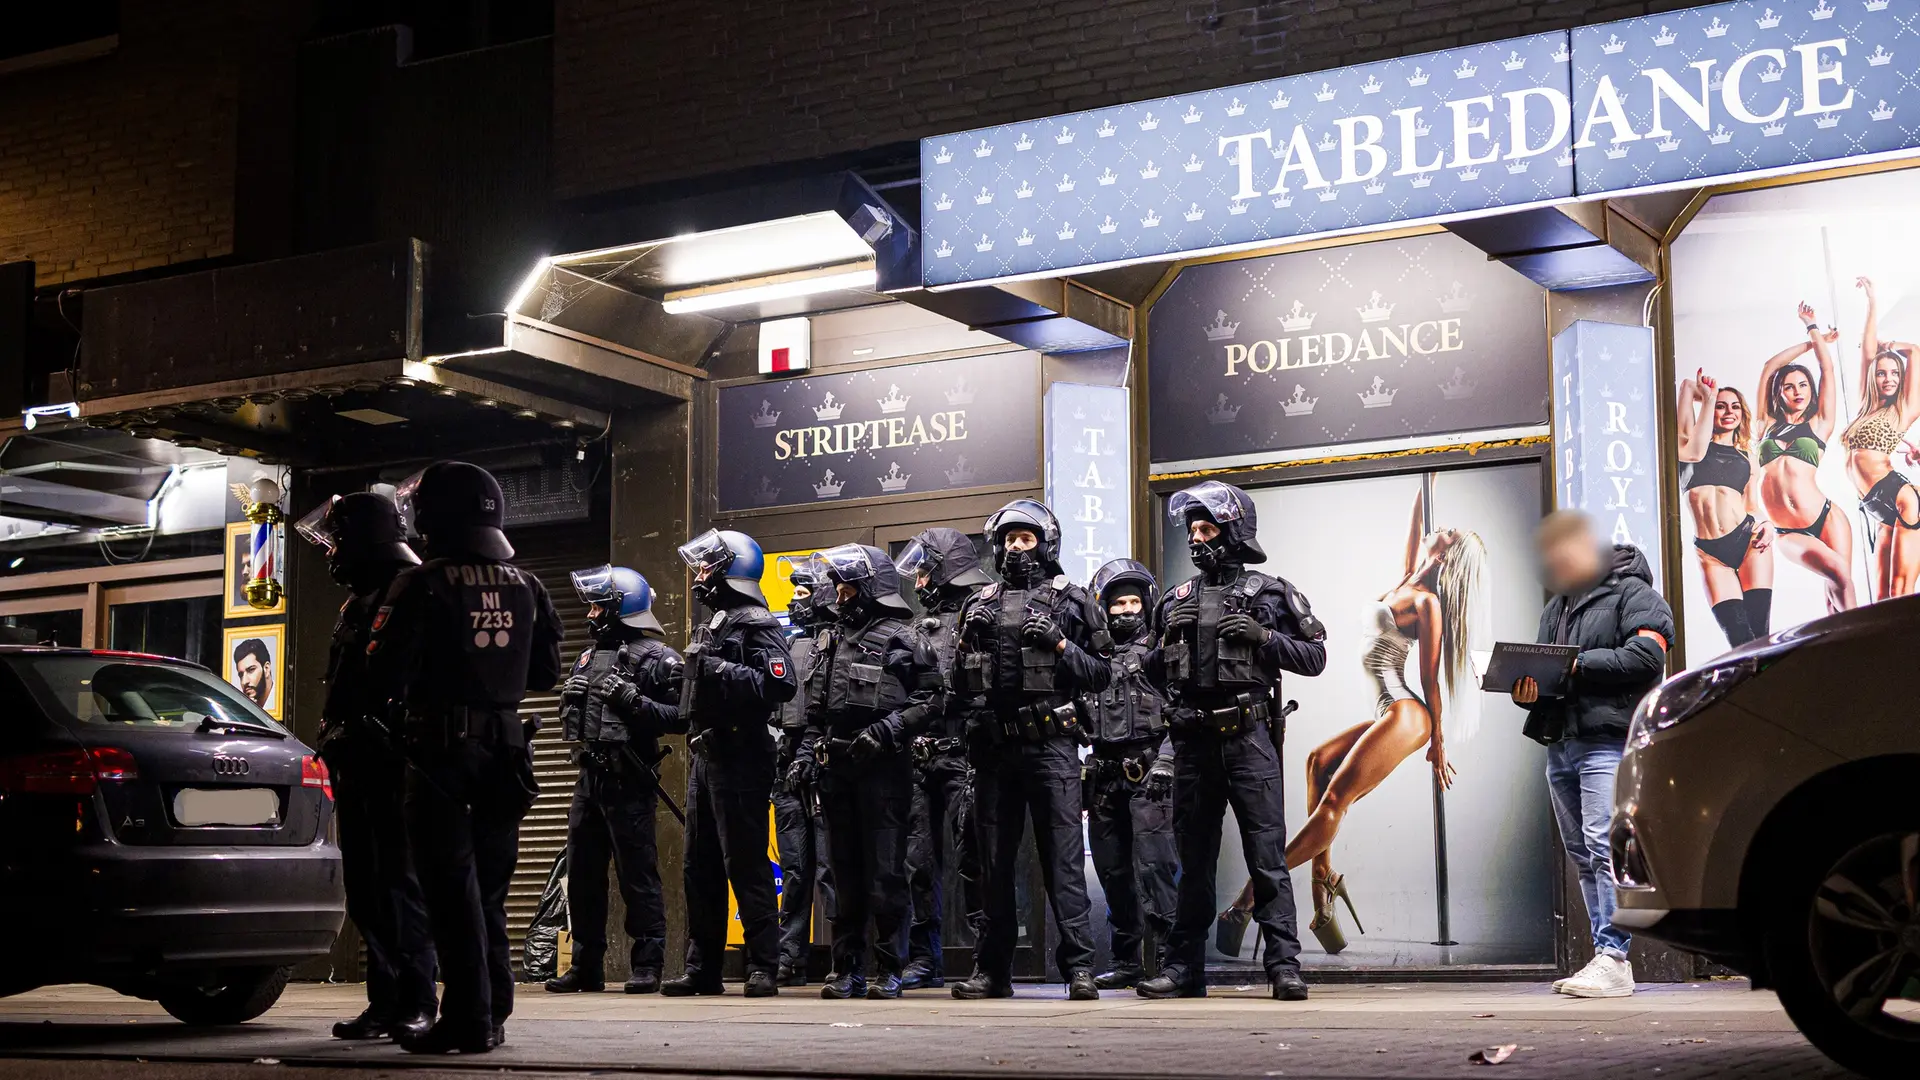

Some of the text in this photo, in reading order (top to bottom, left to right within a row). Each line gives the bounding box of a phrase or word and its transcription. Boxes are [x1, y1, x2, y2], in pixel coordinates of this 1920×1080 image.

[1218, 38, 1855, 202] TABLEDANCE
[1224, 318, 1464, 377] POLEDANCE
[774, 410, 968, 461] STRIPTEASE
[444, 564, 526, 586] POLIZEI
[481, 592, 501, 610] NI
[470, 610, 514, 629] 7233
[1502, 645, 1569, 656] KRIMINALPOLIZEI
[121, 815, 145, 828] A3
